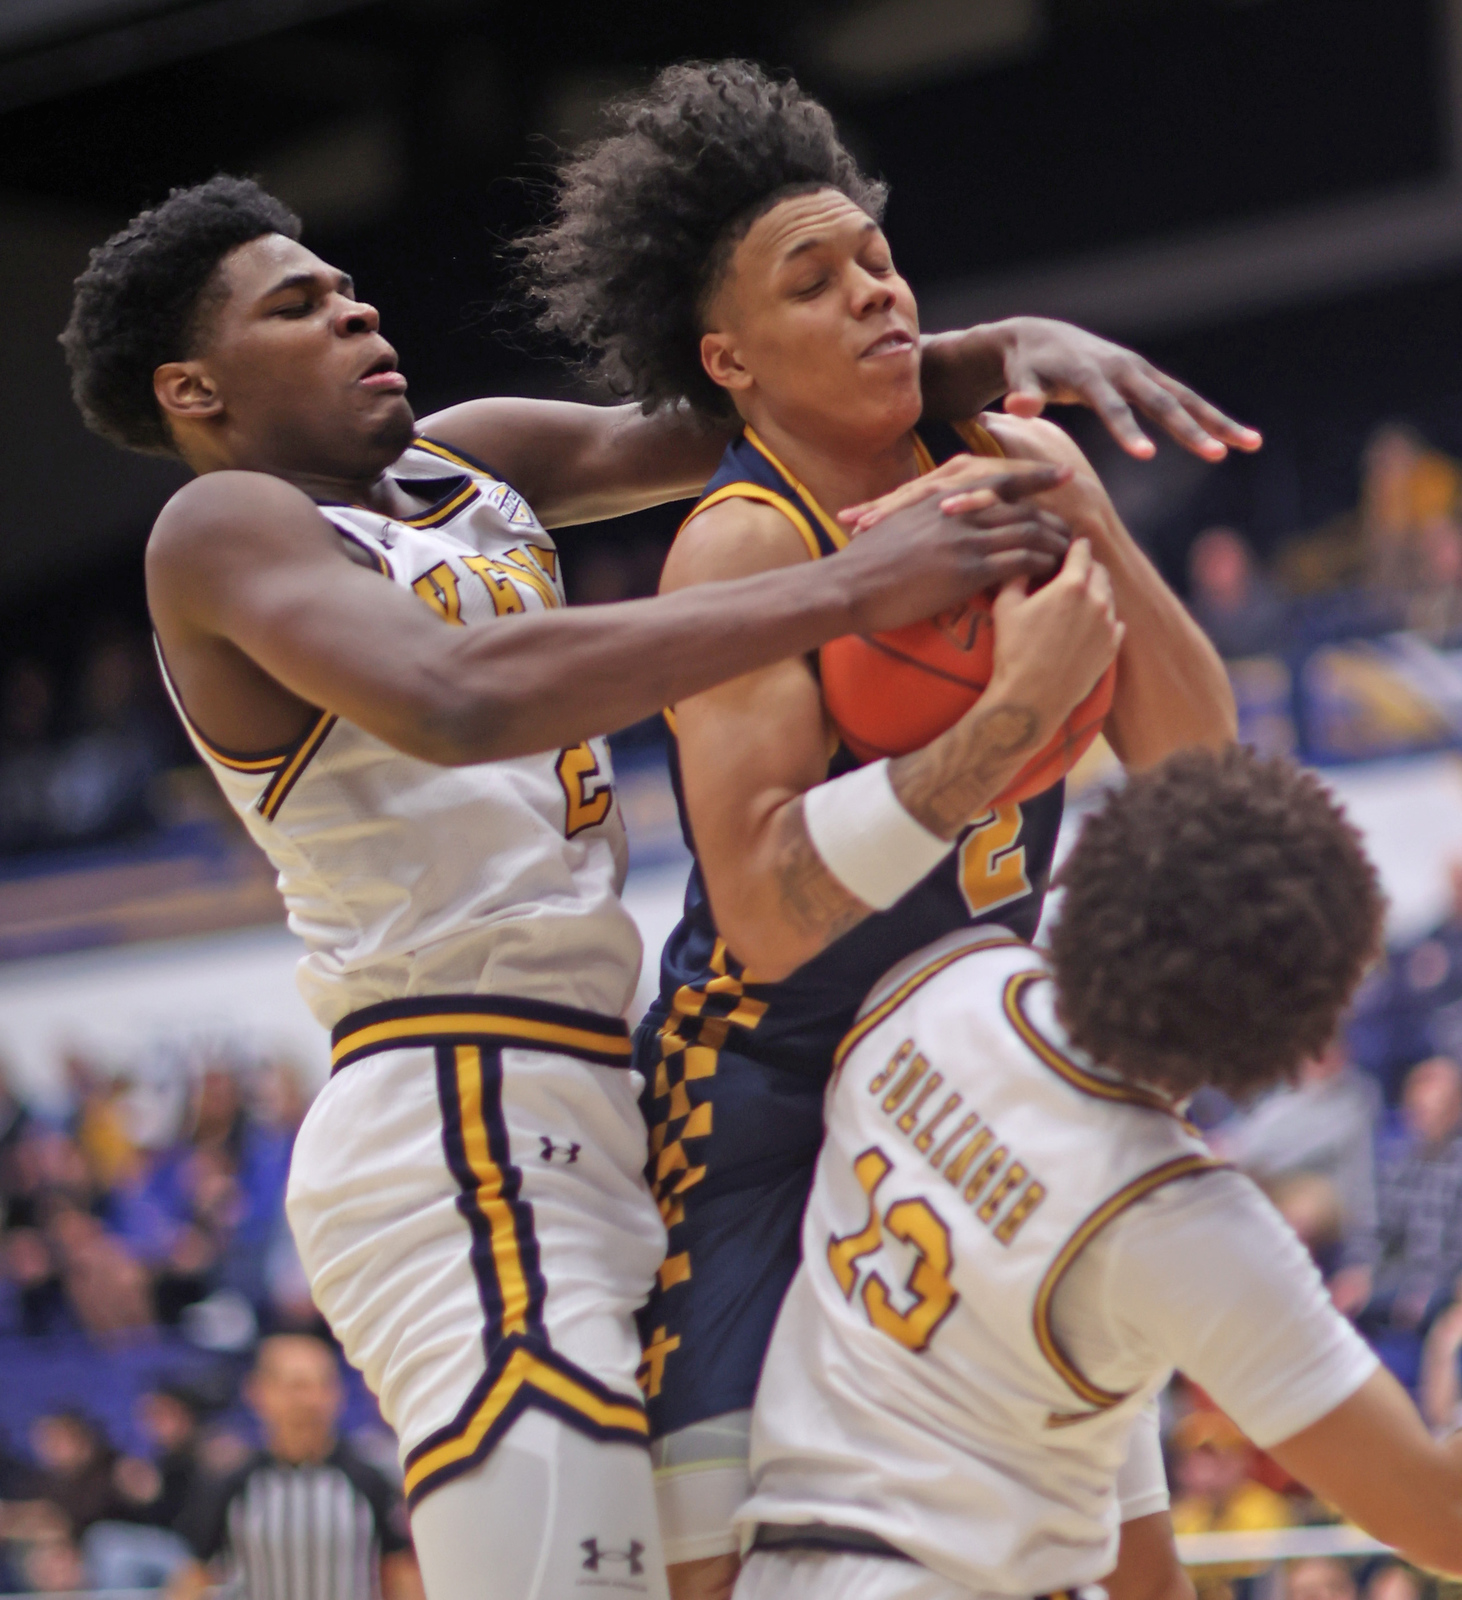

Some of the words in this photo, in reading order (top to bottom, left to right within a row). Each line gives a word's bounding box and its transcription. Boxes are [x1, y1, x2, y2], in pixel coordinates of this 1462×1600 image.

[957, 802, 1033, 918] 2
[868, 1037, 1047, 1248] SULLINGER
[827, 1145, 962, 1355] 13
